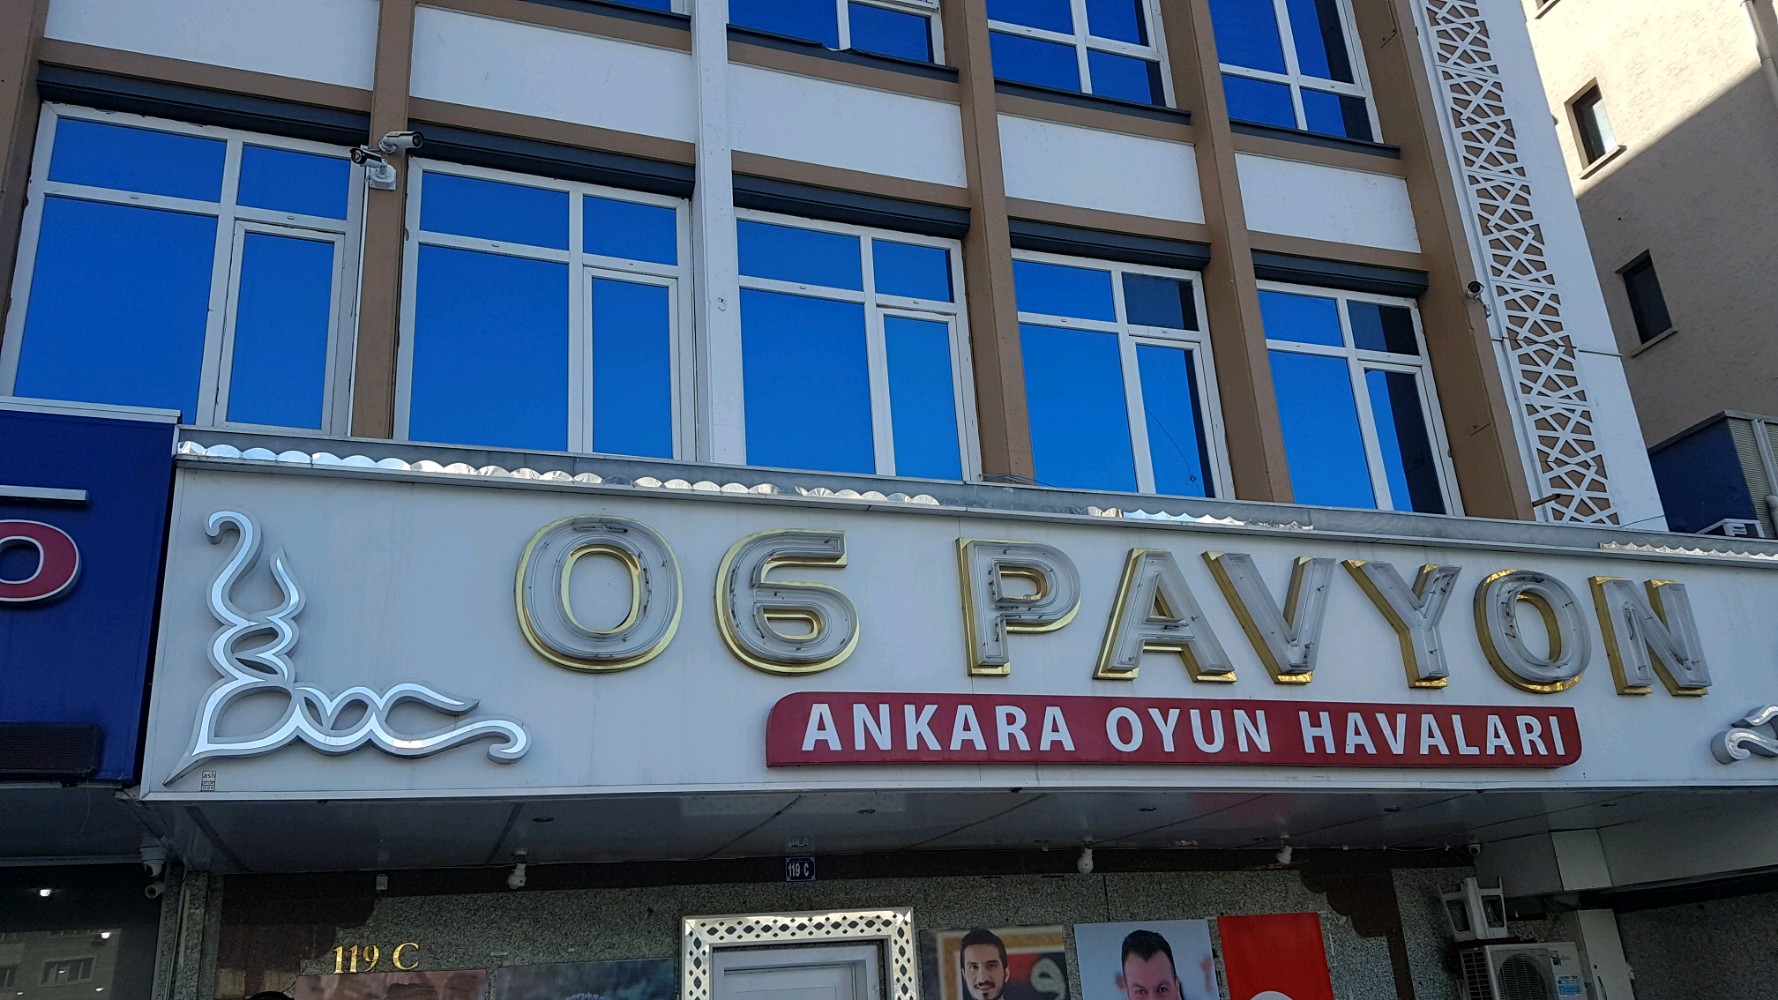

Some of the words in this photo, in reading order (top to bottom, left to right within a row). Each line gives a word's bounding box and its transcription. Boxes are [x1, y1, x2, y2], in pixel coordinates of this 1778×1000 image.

[955, 537, 1712, 696] PAVYON
[801, 702, 1076, 752] ANKARA
[1105, 706, 1271, 754] OYUN
[1299, 710, 1566, 756] HAVALARI
[333, 944, 380, 974] 119
[392, 942, 419, 970] C
